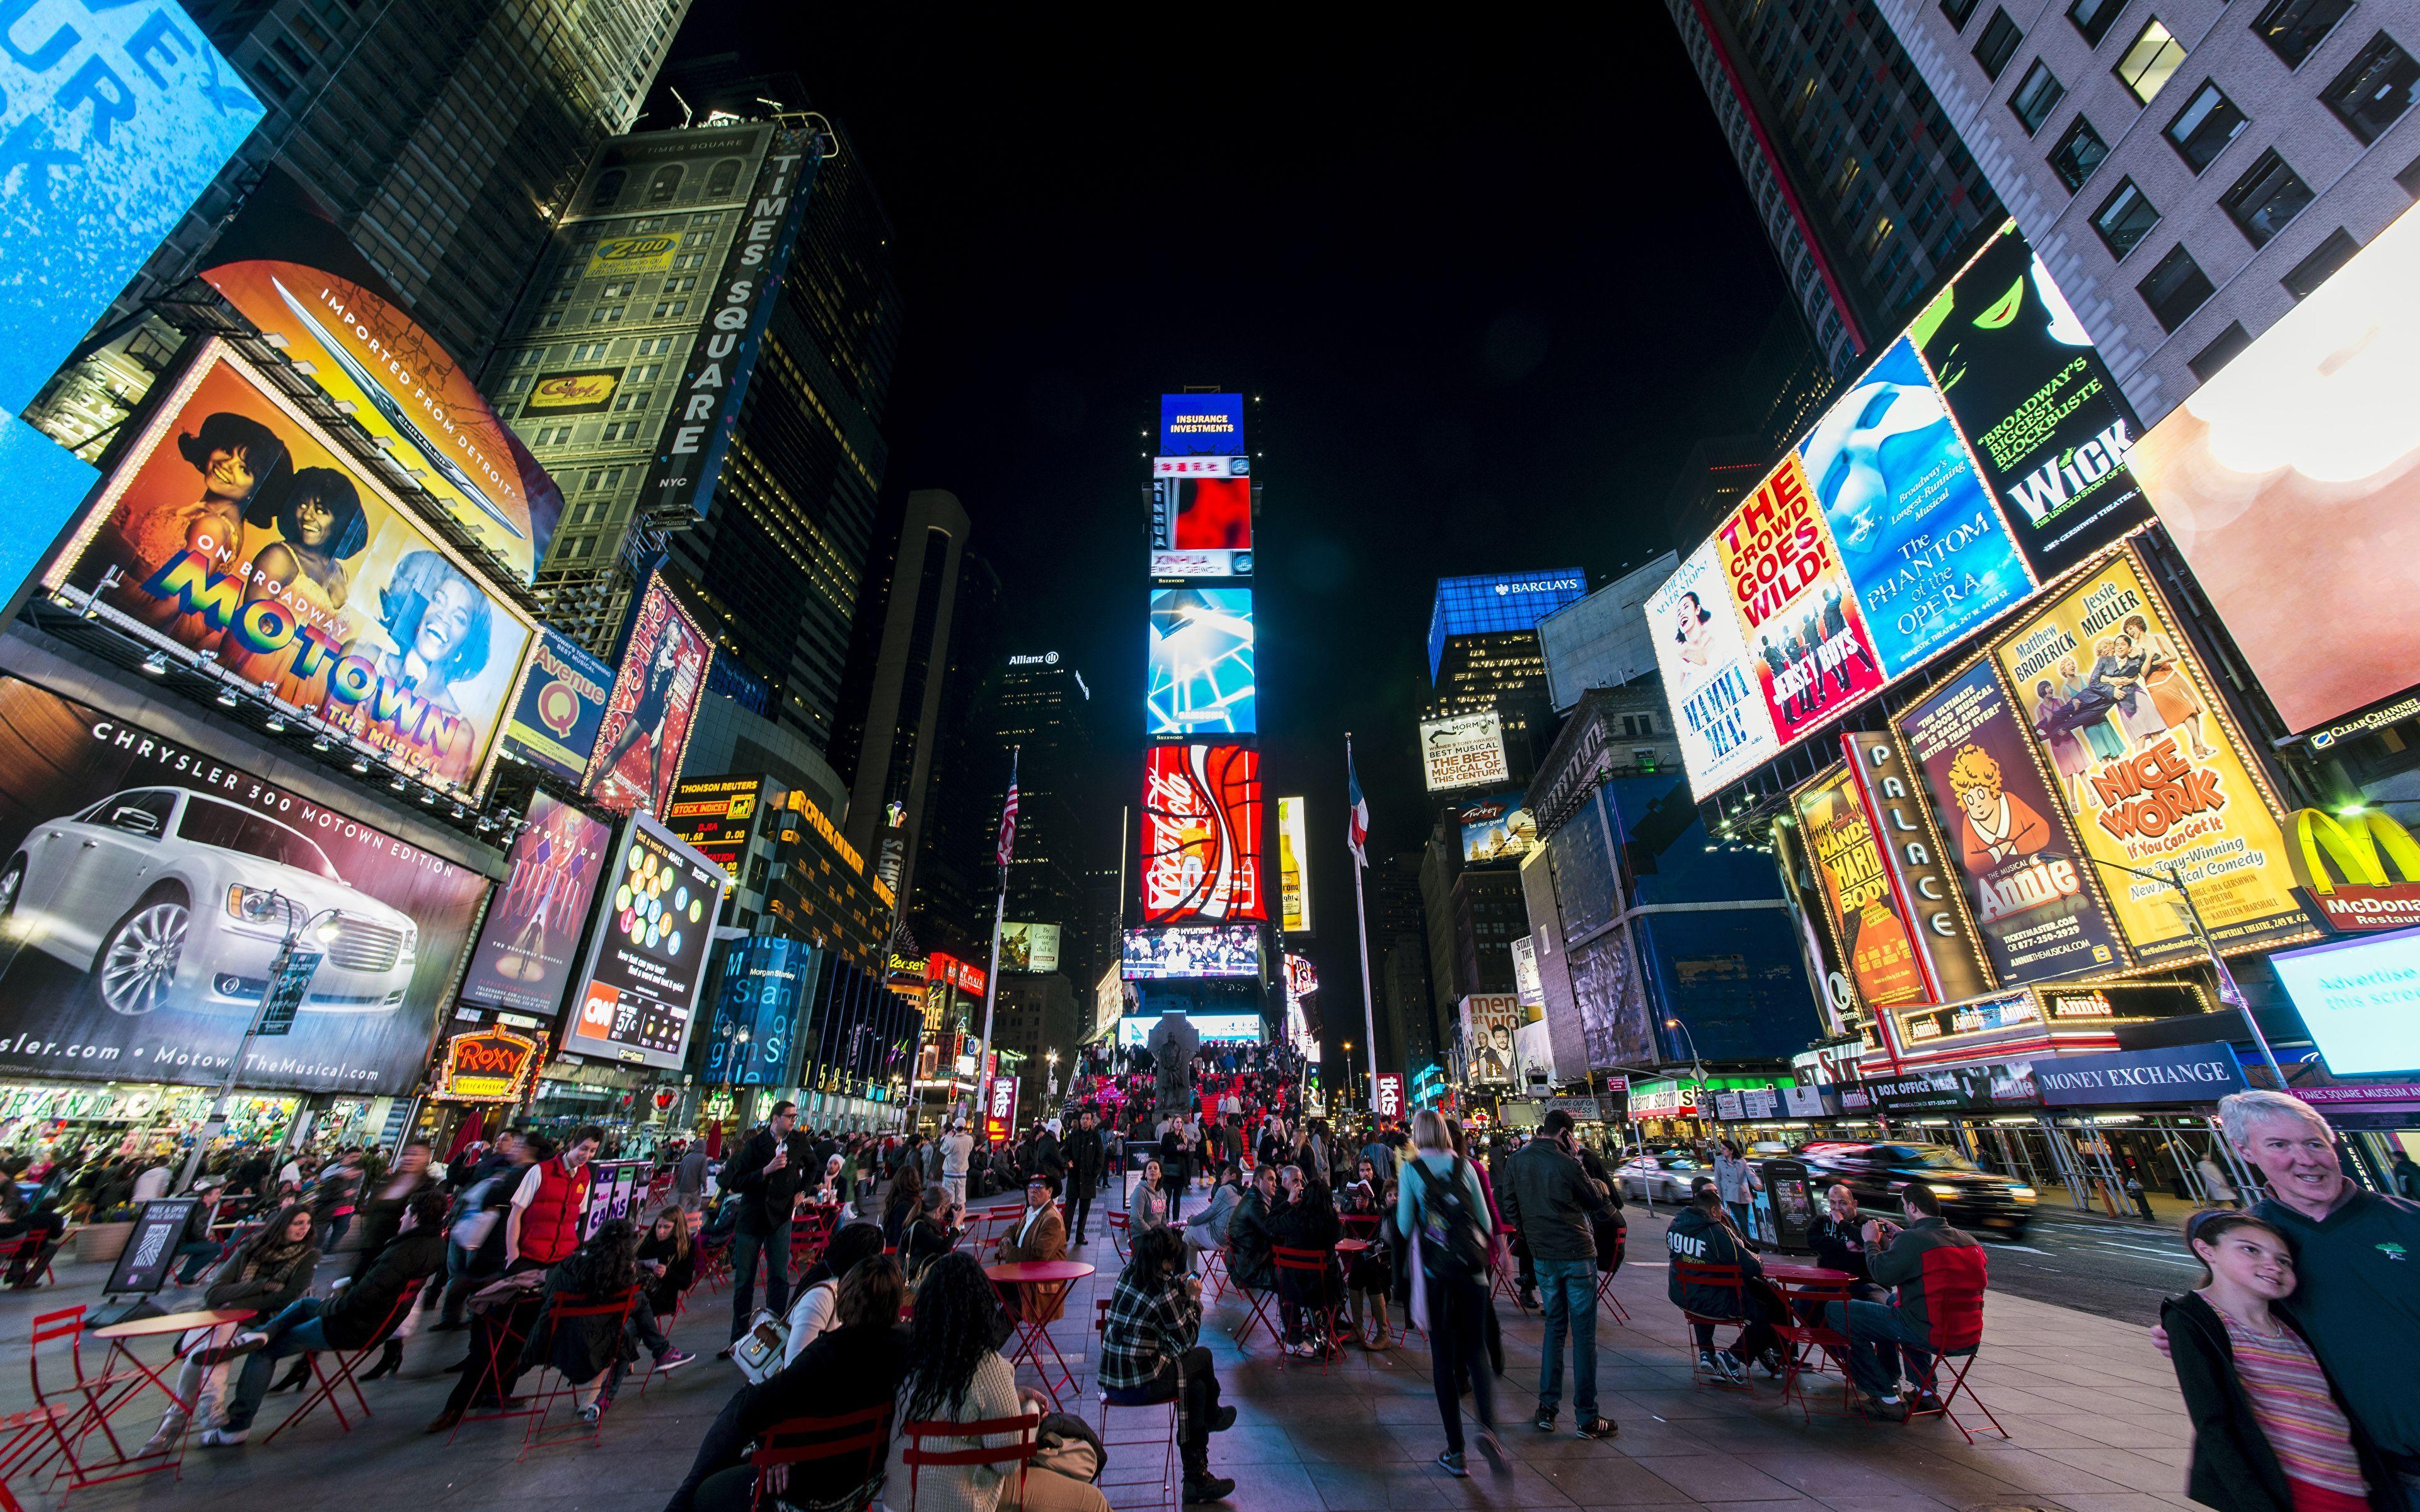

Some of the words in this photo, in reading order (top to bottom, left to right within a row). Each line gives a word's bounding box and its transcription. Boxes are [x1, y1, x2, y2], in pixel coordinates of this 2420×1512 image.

[647, 145, 685, 154] TIMES
[689, 139, 744, 151] SQUARE
[740, 154, 801, 266] TIMES
[602, 239, 671, 260] Z100
[320, 288, 411, 386] IMPORTED
[415, 387, 455, 435] FROM
[671, 281, 752, 455] SQUARE
[1170, 424, 1234, 433] INVESTMENTS
[1176, 415, 1228, 423] INSURANCE
[1988, 397, 2054, 457] BIGGEST
[397, 413, 448, 466] CHRYSLER
[659, 478, 688, 488] NYC
[1891, 460, 1966, 525] Longest-Running
[1915, 488, 1950, 522] Musical
[1730, 495, 1809, 578] CROWD
[1898, 534, 1931, 560] The
[1736, 517, 1819, 604] GOES
[1867, 511, 1991, 612] PHANTOM
[197, 534, 232, 563] ON
[239, 561, 348, 638] BROADWAY
[1512, 579, 1577, 593] BARCLAYS
[1656, 592, 1680, 616] NEVER
[1678, 559, 1709, 594] STOPS!
[1663, 580, 1678, 597] THE
[1676, 560, 1695, 582] FUN
[1911, 580, 1927, 602] of
[1927, 566, 1953, 590] the
[1898, 572, 1983, 636] OPERA
[2080, 589, 2141, 640] MUELLER
[2083, 580, 2118, 617] Jessie
[141, 548, 462, 754] MOTOWN
[556, 643, 572, 657] BEST
[571, 654, 596, 674] MUSICAL
[1009, 655, 1044, 665] Allianz
[2014, 631, 2078, 684] BRODERICK
[2015, 624, 2058, 662] Matthew
[533, 644, 606, 706] Avenue
[1772, 651, 1820, 706] JERSEY
[1816, 626, 1858, 674] BOYS
[538, 680, 580, 739] Q
[1682, 664, 1751, 737] MAMMA
[1911, 711, 1954, 747] FEEL-GOOD
[1955, 684, 1995, 716] MUSICAL
[1935, 684, 1976, 716] ULTIMATE
[328, 705, 366, 737] THE
[367, 727, 441, 776] MUSICAL
[1472, 736, 1498, 744] AWARDS
[1703, 706, 1748, 763] MIA!
[1919, 739, 1949, 762] BETTER
[1947, 723, 1973, 743] THAN
[1928, 733, 1938, 746] IS
[1937, 718, 1961, 740] BACK
[1961, 705, 1981, 724] AND
[1429, 748, 1452, 759] BEST
[1455, 742, 1499, 754] MUSICAL
[1431, 762, 1483, 777] MUSICAL
[1484, 759, 1501, 769] OF
[1461, 750, 1499, 764] BEST
[681, 784, 720, 794] THOMSON
[720, 781, 758, 791] REUTERS
[1432, 774, 1455, 784] THIS
[2090, 737, 2194, 808] NICE
[93, 723, 238, 790] CHRYSLER
[248, 785, 291, 812] 300
[301, 806, 384, 850] MOTOWN
[390, 842, 454, 878] EDITION
[674, 805, 698, 814] STOCK
[700, 803, 727, 813] INDICES
[1462, 806, 1497, 818] Turkey
[2098, 768, 2227, 842] WORK
[698, 823, 718, 832] DJIA
[725, 830, 745, 840] 0.00
[1489, 817, 1504, 827] guest
[1818, 818, 1872, 861] HANDS
[533, 825, 572, 849] JOIN
[580, 847, 597, 861] US
[635, 829, 647, 844] Text
[650, 839, 664, 854] word
[668, 850, 685, 868] 40411
[1869, 744, 1957, 937] PALACE
[1831, 839, 1883, 890] HARD
[1988, 871, 2000, 881] THE
[2000, 859, 2029, 876] MUSICAL
[497, 859, 588, 942] PIPPIN
[1840, 876, 1889, 915] BODY
[1978, 853, 2081, 924] Annie
[2325, 898, 2420, 914] McDona
[2003, 915, 2078, 944] TICKETMASTER.COM
[2007, 944, 2019, 953] OR
[2017, 925, 2080, 950] 877-250-2929
[507, 944, 538, 958] BROADWAY
[540, 954, 563, 965] MUSICAL
[1521, 948, 1533, 960] THE
[2010, 939, 2091, 967] ANNIETHEMUSICAL.COM
[750, 968, 774, 977] Morgan
[775, 970, 795, 980] Stanley
[584, 997, 616, 1028] CNN
[1470, 995, 1518, 1014] men
[1472, 1014, 1484, 1025] at
[458, 1040, 524, 1074] ROXY
[457, 1081, 505, 1091] DELICATESSEN
[1877, 1084, 1898, 1096] BOX
[1898, 1080, 1930, 1094] OFFICE
[1931, 1077, 1959, 1091] HERE
[2042, 1071, 2106, 1091] MONEY
[2107, 1062, 2232, 1088] EXCHANGE
[2297, 1091, 2327, 1099] TIMES
[2327, 1089, 2363, 1099] SQUARE
[2363, 1088, 2410, 1098] MUSEUM
[174, 1097, 253, 1120] SLM
[993, 1080, 1013, 1118] tkts
[1380, 1076, 1398, 1116] tkts
[1654, 1088, 1676, 1108] sbarro
[148, 1205, 163, 1213] FREE
[164, 1205, 171, 1213] &
[171, 1205, 190, 1213] OPEN
